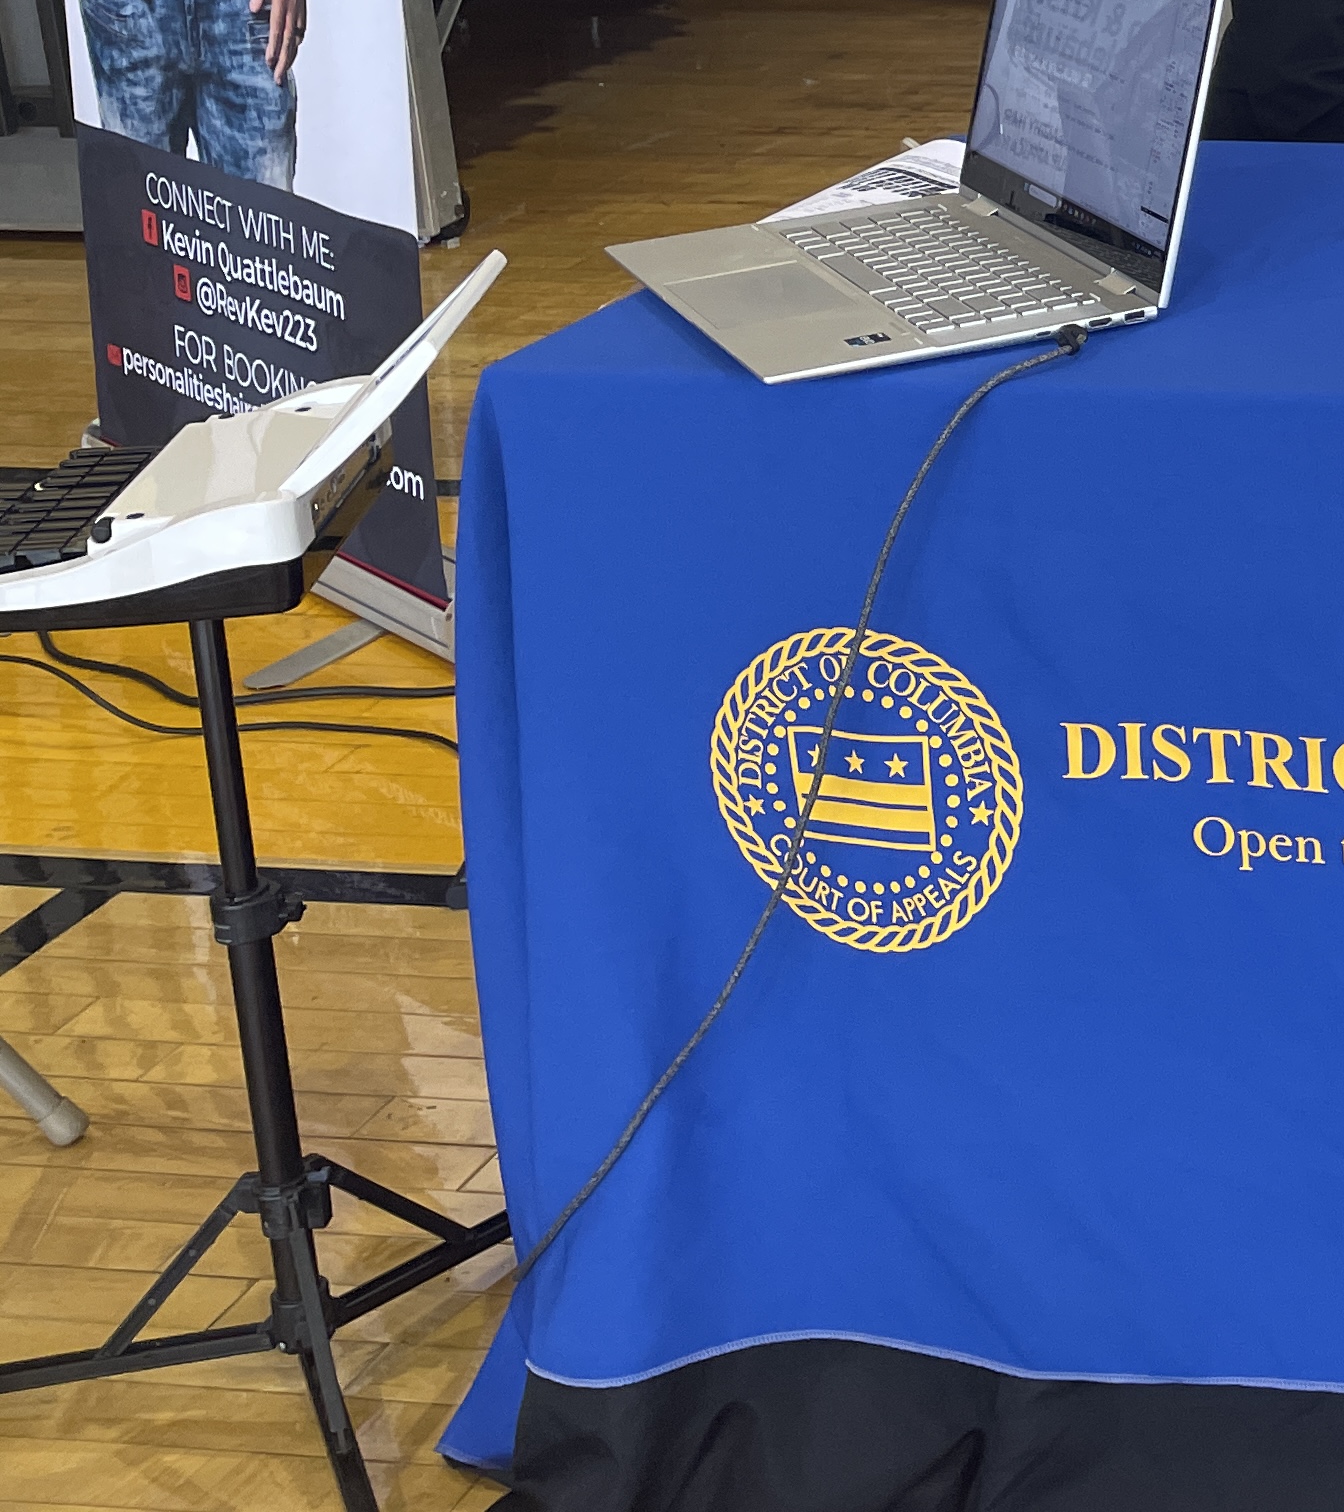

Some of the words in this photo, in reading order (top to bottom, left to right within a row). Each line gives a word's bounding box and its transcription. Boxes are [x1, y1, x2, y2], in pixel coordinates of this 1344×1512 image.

[145, 171, 233, 234] CONNECT
[237, 205, 296, 255] WITH
[301, 224, 337, 272] ME:
[161, 219, 215, 268] Kevin
[216, 244, 346, 321] Quattlebaum
[195, 276, 319, 352] @RevKev223
[172, 323, 218, 374] FOR
[223, 342, 317, 399] BOOKIN
[737, 662, 813, 789] DISTRICT
[867, 660, 993, 801] COLUMBIA
[1192, 815, 1325, 871] Open
[847, 897, 884, 924] OF
[891, 850, 978, 924] APPEALS
